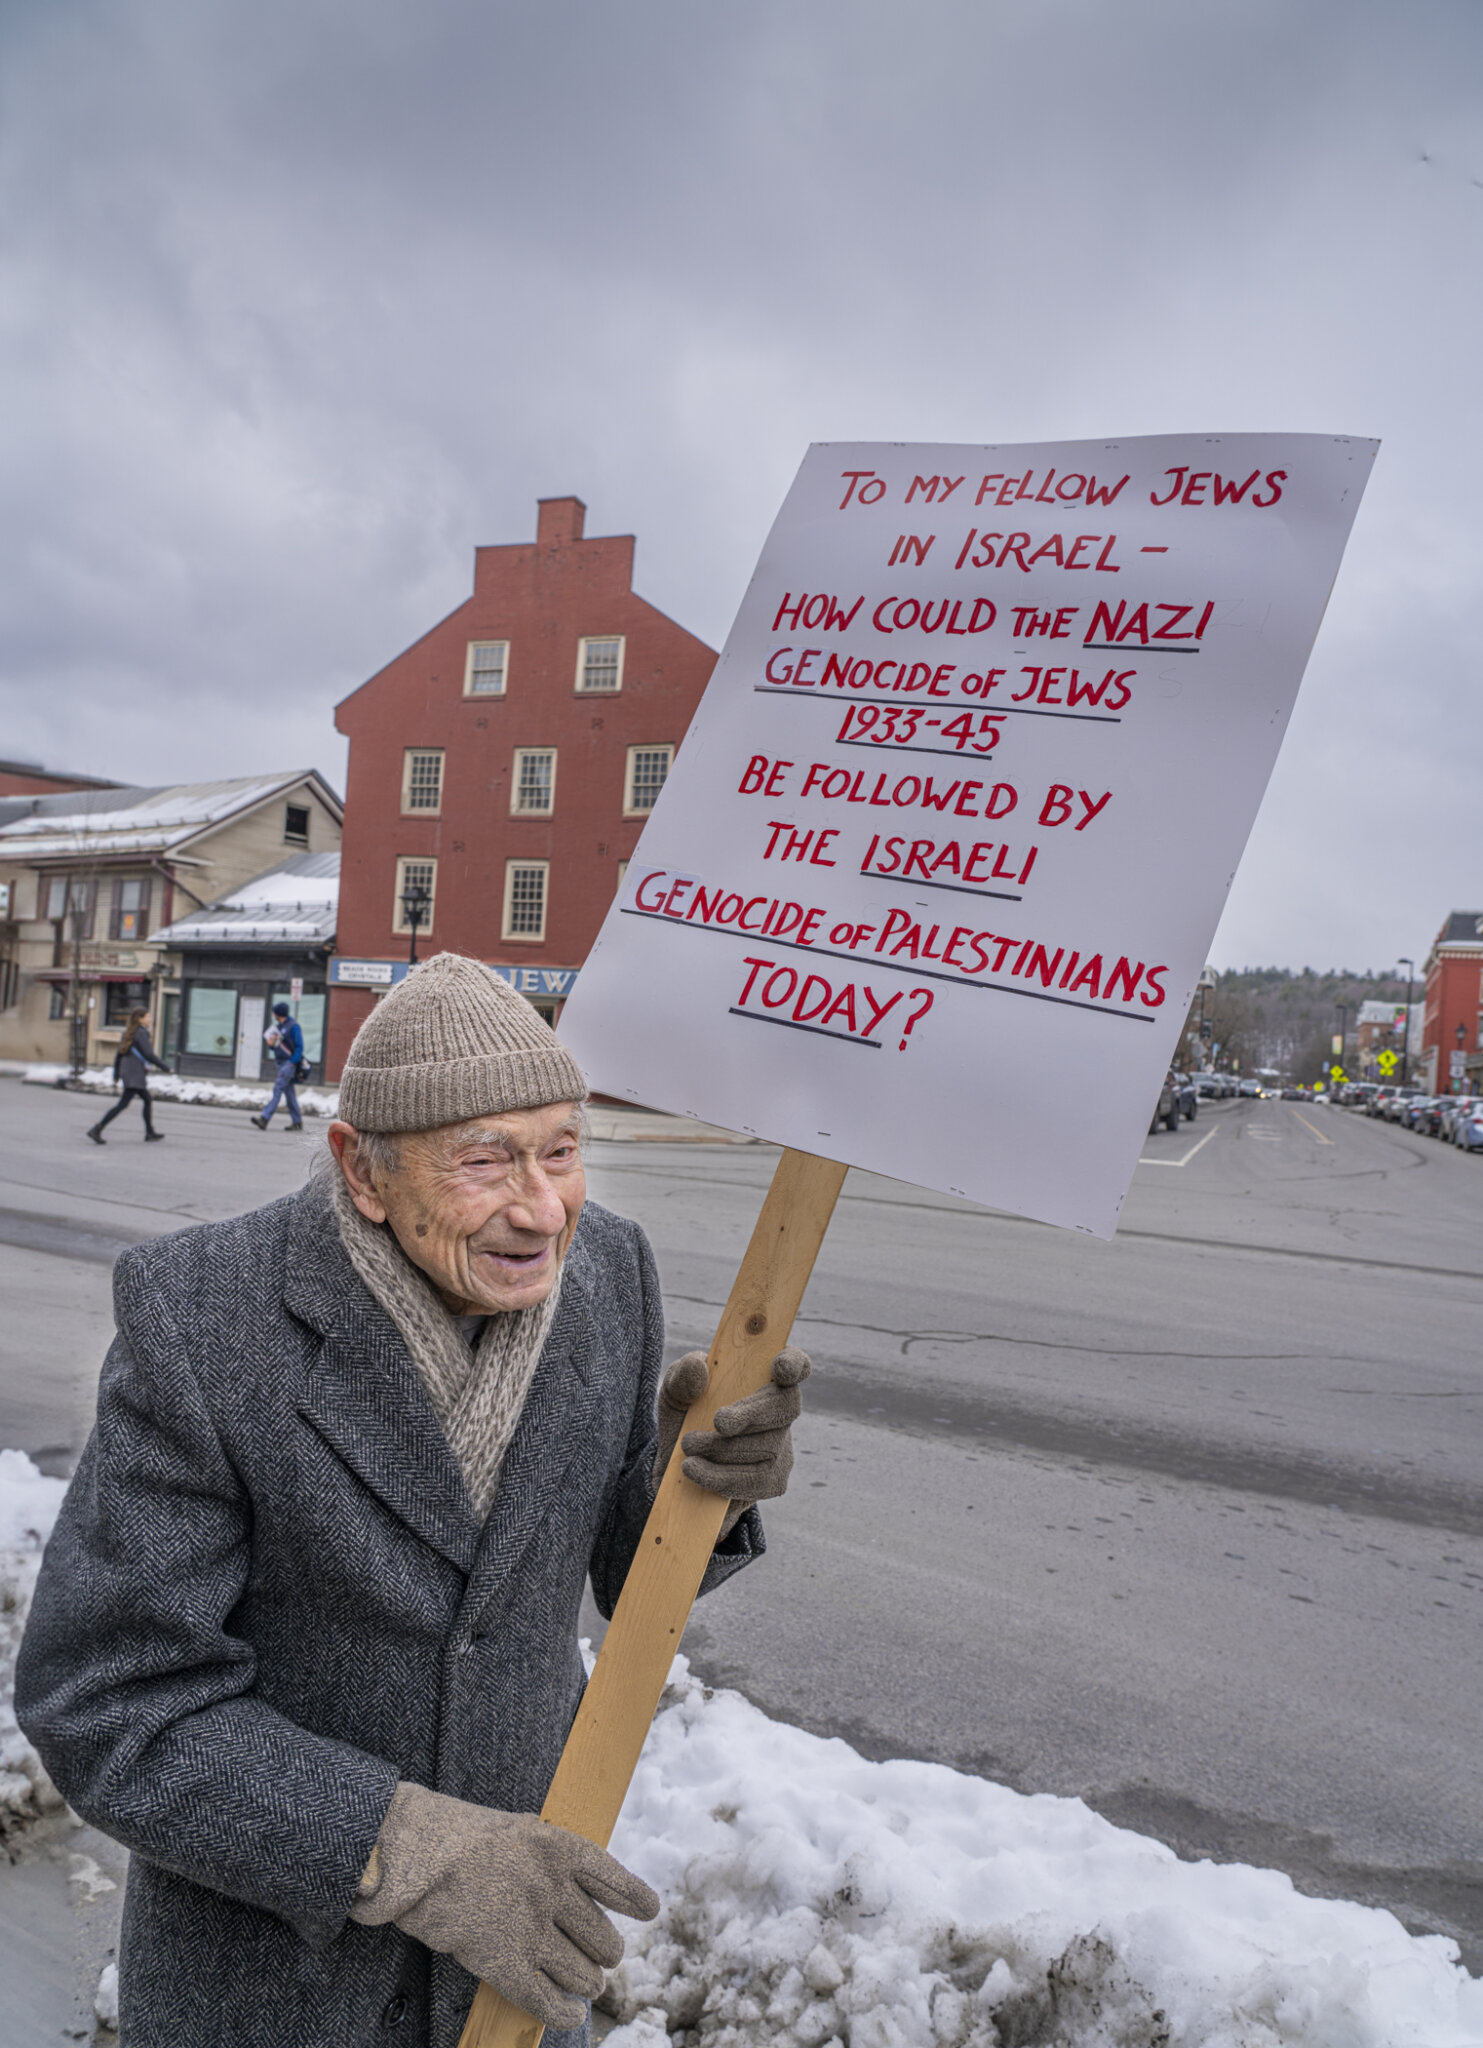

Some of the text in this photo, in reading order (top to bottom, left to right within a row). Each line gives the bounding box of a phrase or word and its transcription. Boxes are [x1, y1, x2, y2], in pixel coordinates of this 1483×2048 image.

[839, 466, 1288, 510] TO MY FELLOW JEWS
[887, 535, 936, 567] IN
[954, 527, 1121, 573] ISRAEL
[771, 592, 1215, 645] HOW COULD THE NAZI
[765, 647, 957, 697] GENOCIDE
[1010, 666, 1137, 711] JEWS
[836, 704, 1008, 753] 1933-45
[737, 754, 1113, 832] BE FOLLOWED BY
[762, 820, 1039, 885] THE ISRAELI
[635, 871, 827, 946] GENOCIDE
[874, 908, 1169, 1008] PALESTINIANS
[507, 969, 580, 992] JEW
[737, 956, 935, 1052] TODAY?
